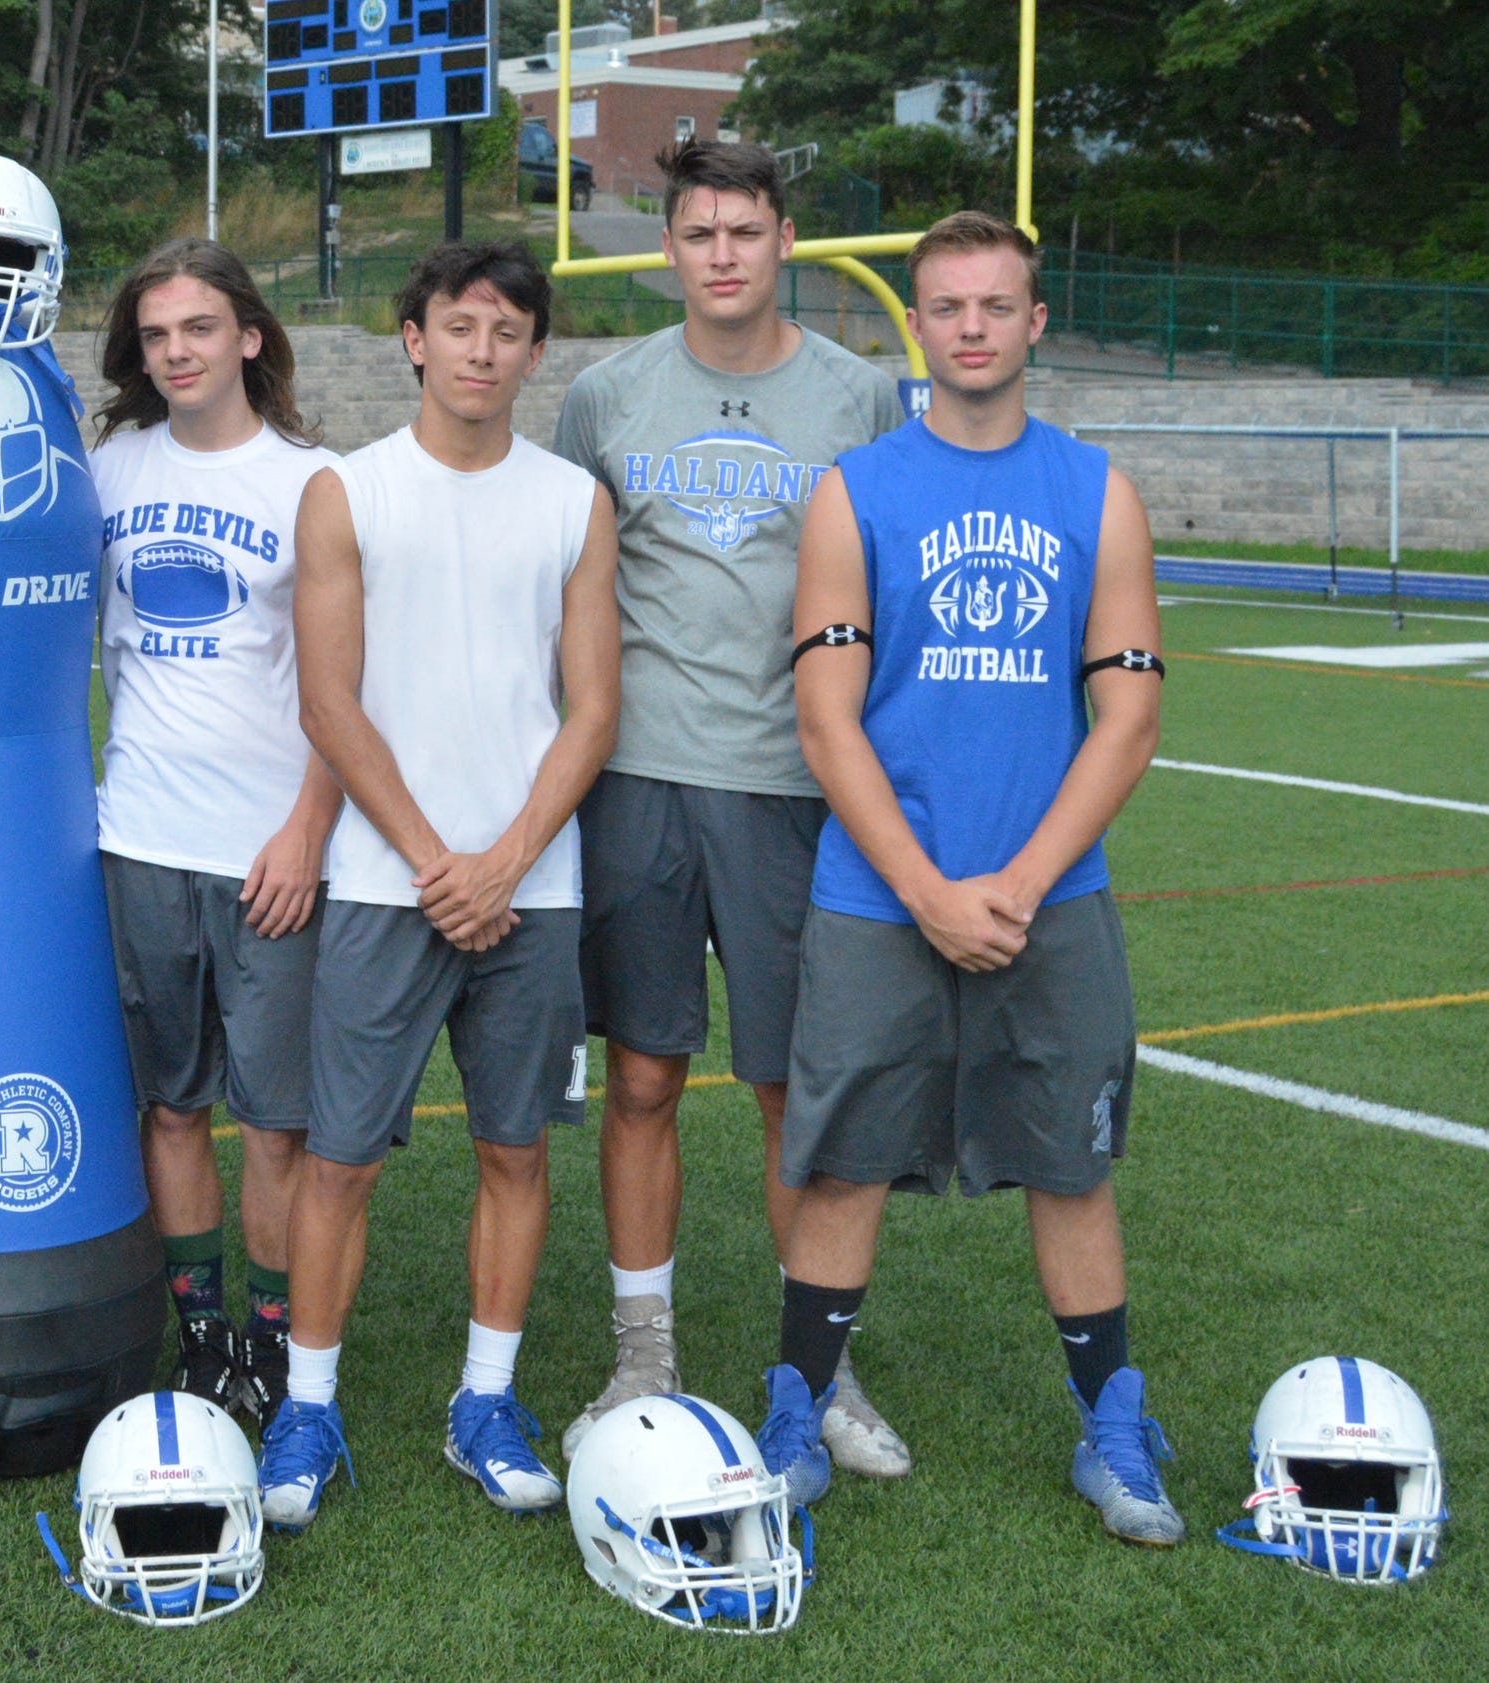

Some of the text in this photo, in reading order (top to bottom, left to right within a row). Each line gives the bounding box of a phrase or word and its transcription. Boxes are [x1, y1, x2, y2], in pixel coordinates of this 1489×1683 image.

[103, 503, 279, 563] BLUE DEVILS
[919, 511, 1061, 582] HALDANE
[1, 571, 91, 606] DRIVE
[140, 632, 220, 658] ELITE
[918, 646, 1049, 682] FOOTBALL
[47, 1095, 73, 1161] COMPANY
[1336, 1426, 1376, 1438] Riddell
[150, 1469, 190, 1480] Riddell
[722, 1468, 754, 1483] Riddell
